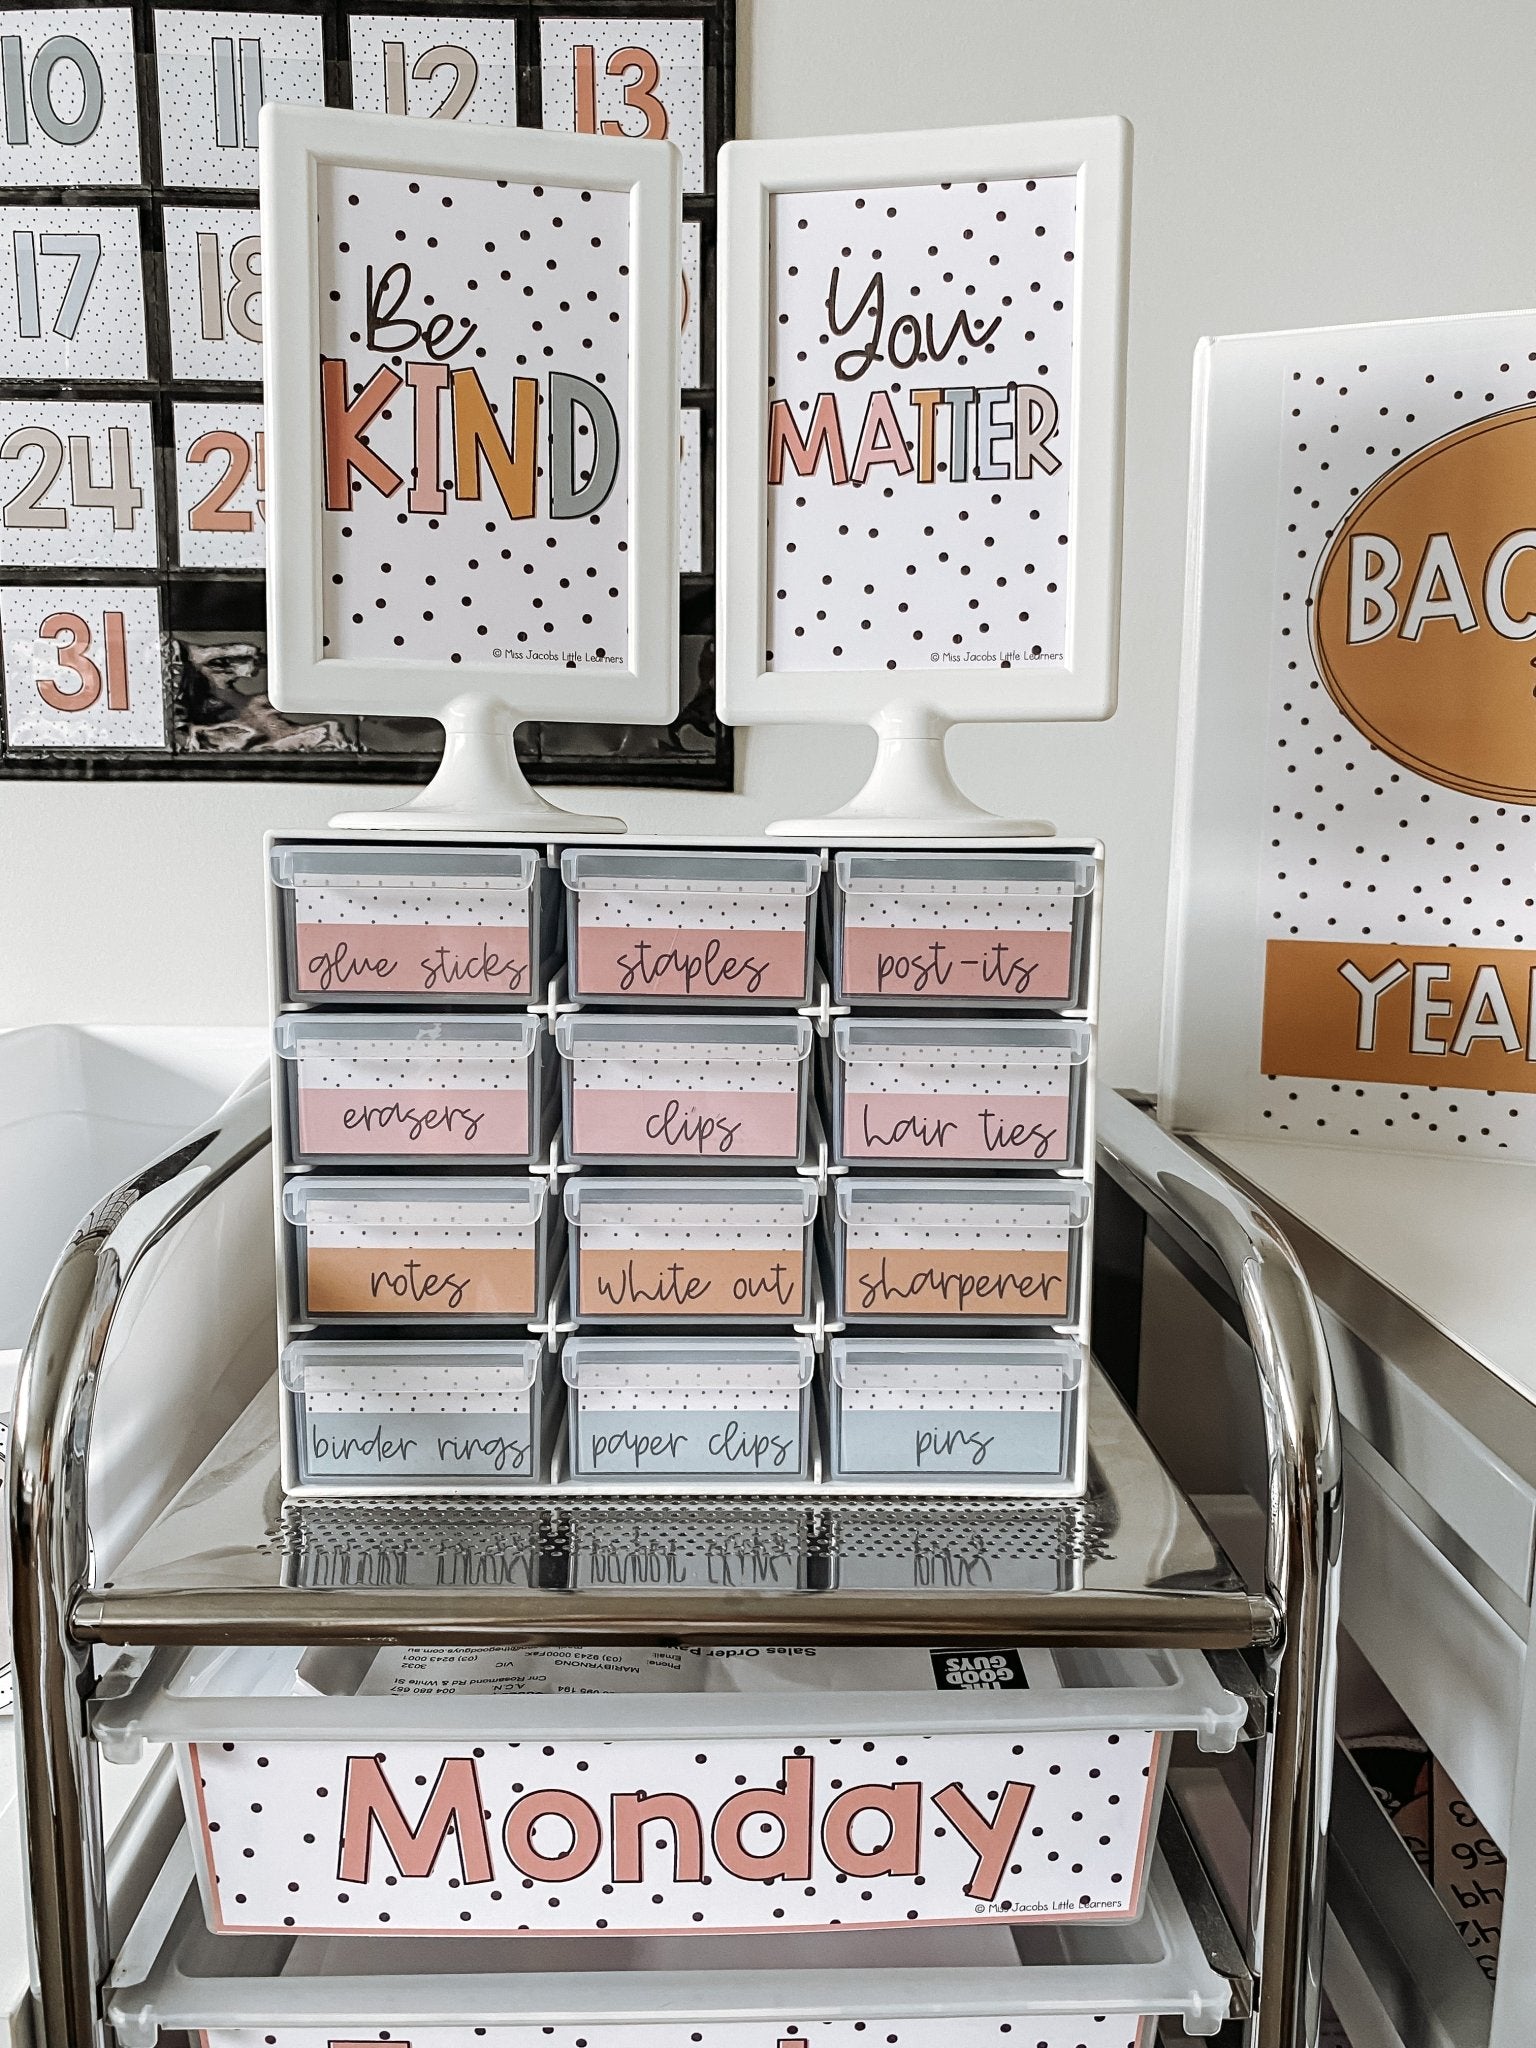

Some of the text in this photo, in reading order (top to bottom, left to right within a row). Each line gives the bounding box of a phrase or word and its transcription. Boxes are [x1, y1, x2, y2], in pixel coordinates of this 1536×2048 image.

[1, 35, 103, 145] 10
[211, 37, 263, 148] 11
[383, 41, 478, 120] 12
[573, 45, 669, 140] 13
[13, 230, 102, 340] 17
[366, 262, 478, 361] Be
[826, 267, 1001, 381] You
[320, 358, 621, 520] KIND
[767, 384, 1063, 487] MATTER
[0, 426, 143, 530] 24
[186, 430, 265, 532] 2
[36, 611, 130, 712] 31
[505, 649, 524, 660] Miss
[526, 649, 559, 661] Jacobs
[562, 651, 582, 662] Little
[942, 652, 961, 662] Miss
[963, 651, 997, 661] Jacobs
[1000, 650, 1021, 661] Little
[1024, 651, 1064, 661] Learners
[309, 942, 529, 990] glue sticks
[617, 939, 770, 994] staples
[878, 942, 1039, 993] post-its
[1337, 958, 1536, 1063] YEA
[344, 1102, 485, 1141] erasers
[646, 1099, 742, 1153] clips
[864, 1104, 1058, 1158] hair ties
[371, 1259, 471, 1308] notes
[598, 1260, 794, 1305] white out
[313, 1425, 531, 1471] binder rings
[592, 1421, 794, 1469] paper clips
[915, 1427, 995, 1467] pins
[554, 1659, 640, 1673] MARIBYRNONG
[603, 1655, 622, 1663] (03)
[706, 1647, 761, 1658] Order
[767, 1647, 817, 1657] Sales
[946, 1655, 1007, 1672] GUYS
[946, 1668, 1014, 1684] GOOD
[336, 1755, 1036, 1902] Monday
[1451, 1838, 1507, 1869] 56
[1012, 1901, 1049, 1912] Jacobs
[1052, 1900, 1075, 1911] Little
